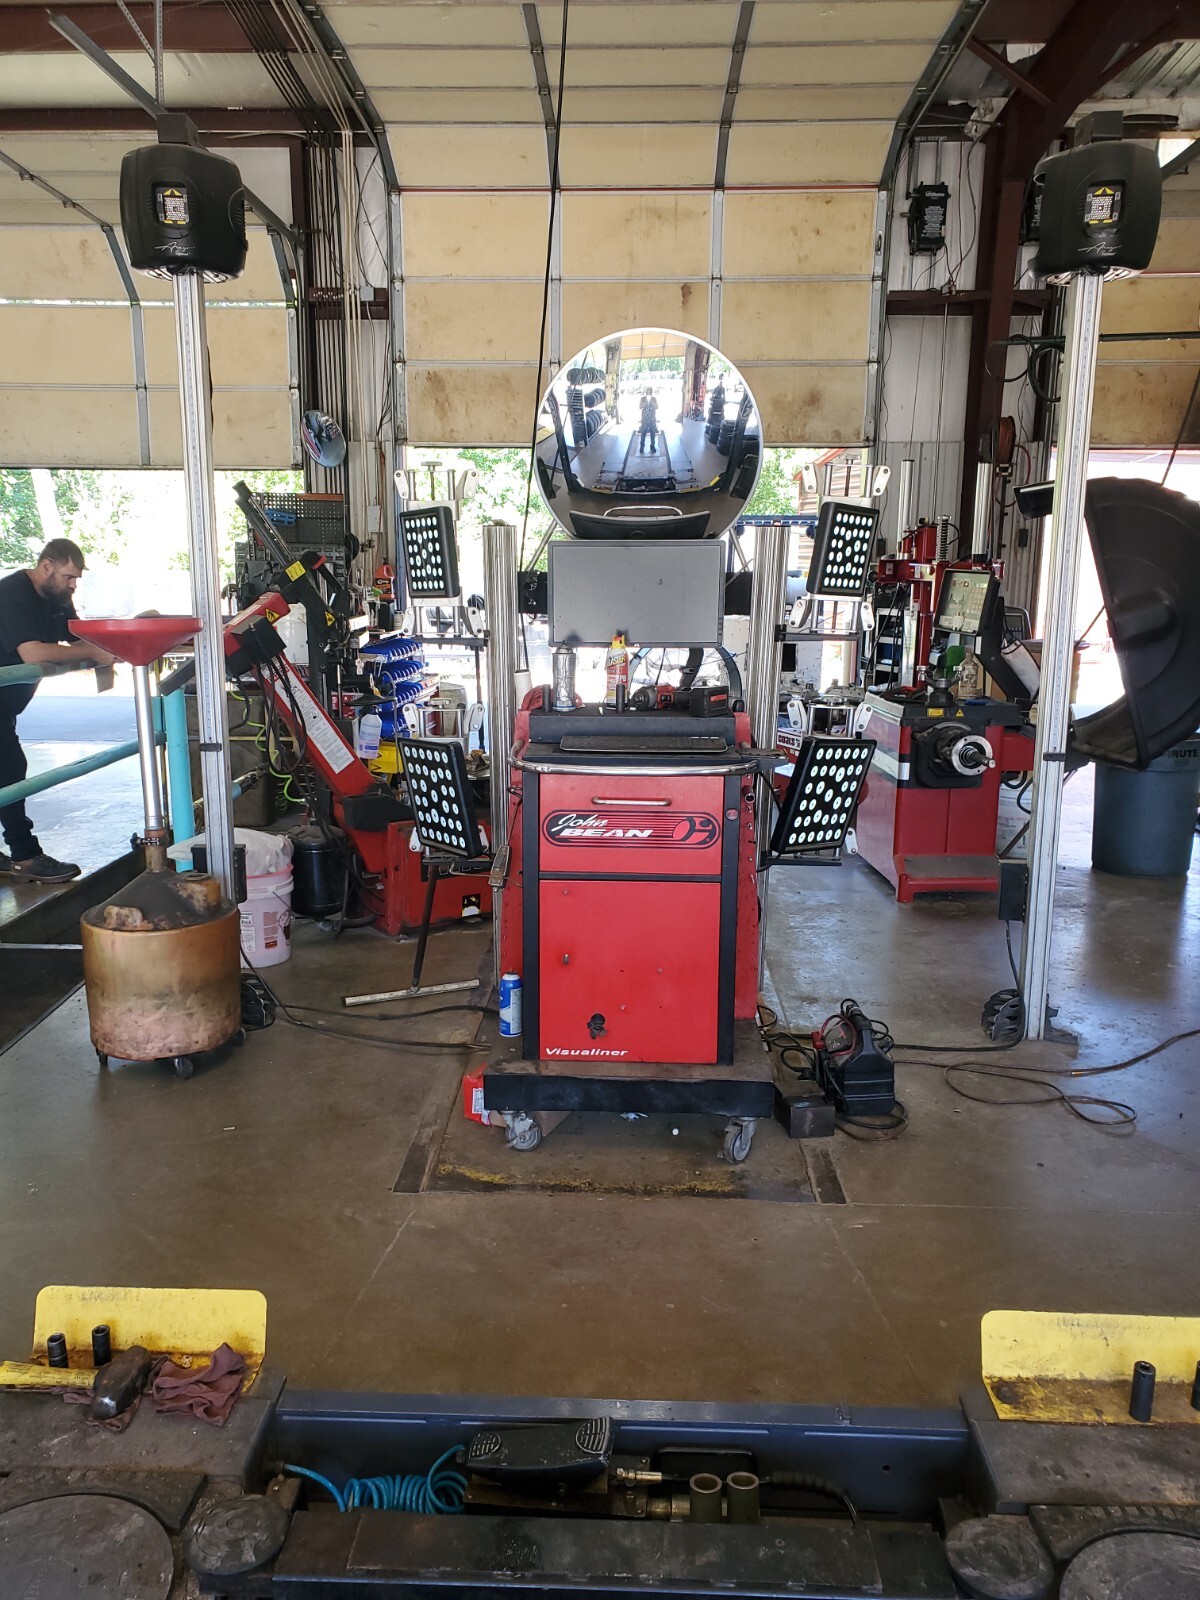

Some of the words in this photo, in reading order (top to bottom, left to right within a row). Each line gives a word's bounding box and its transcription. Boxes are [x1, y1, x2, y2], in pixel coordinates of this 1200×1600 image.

[551, 813, 609, 832] John
[559, 828, 653, 838] BEAN
[545, 1047, 629, 1057] Visualiner
